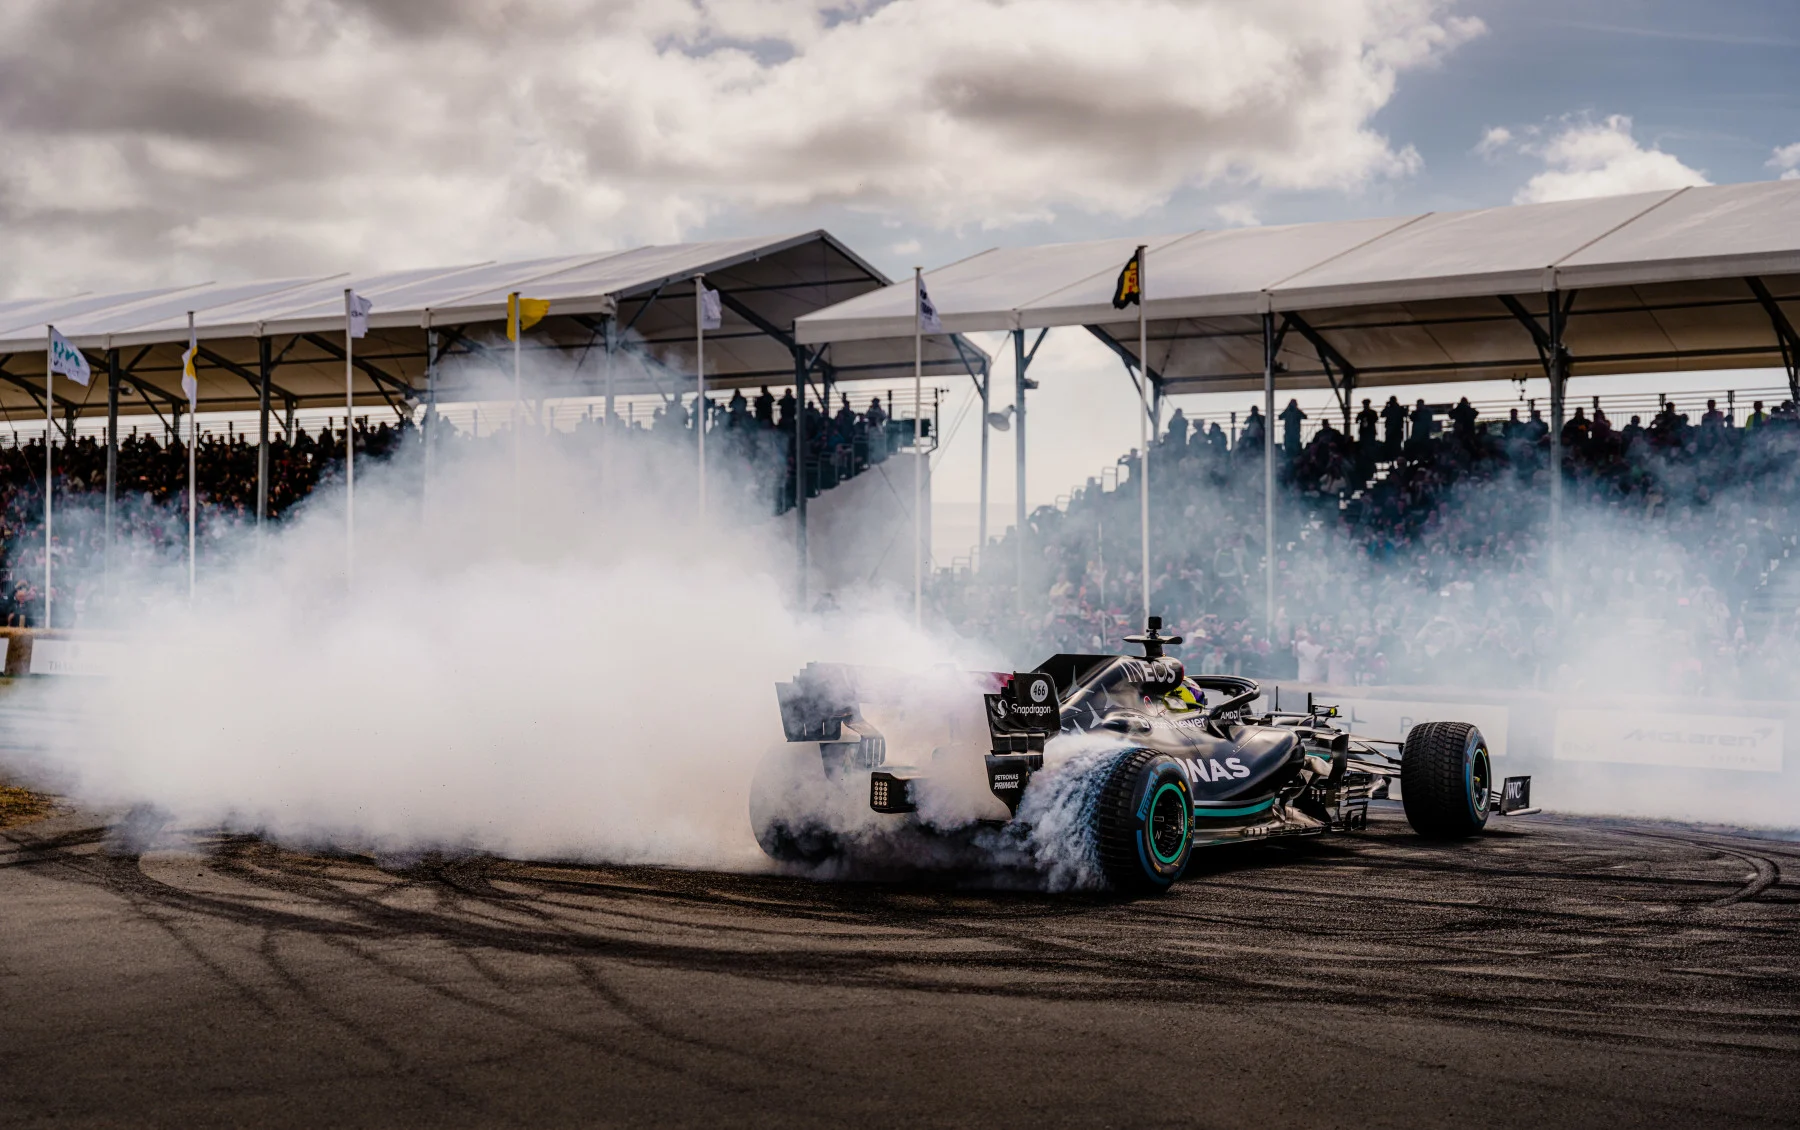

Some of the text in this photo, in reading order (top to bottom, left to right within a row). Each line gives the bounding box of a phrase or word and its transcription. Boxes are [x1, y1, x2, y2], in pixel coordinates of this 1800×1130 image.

[1120, 661, 1176, 683] INEOS
[1033, 685, 1046, 696] 466
[1011, 704, 1051, 717] Snapdragon
[1221, 711, 1234, 720] AMD
[1623, 728, 1757, 749] McLaren
[994, 781, 1019, 790] PRIMAX
[1506, 782, 1521, 800] IWC
